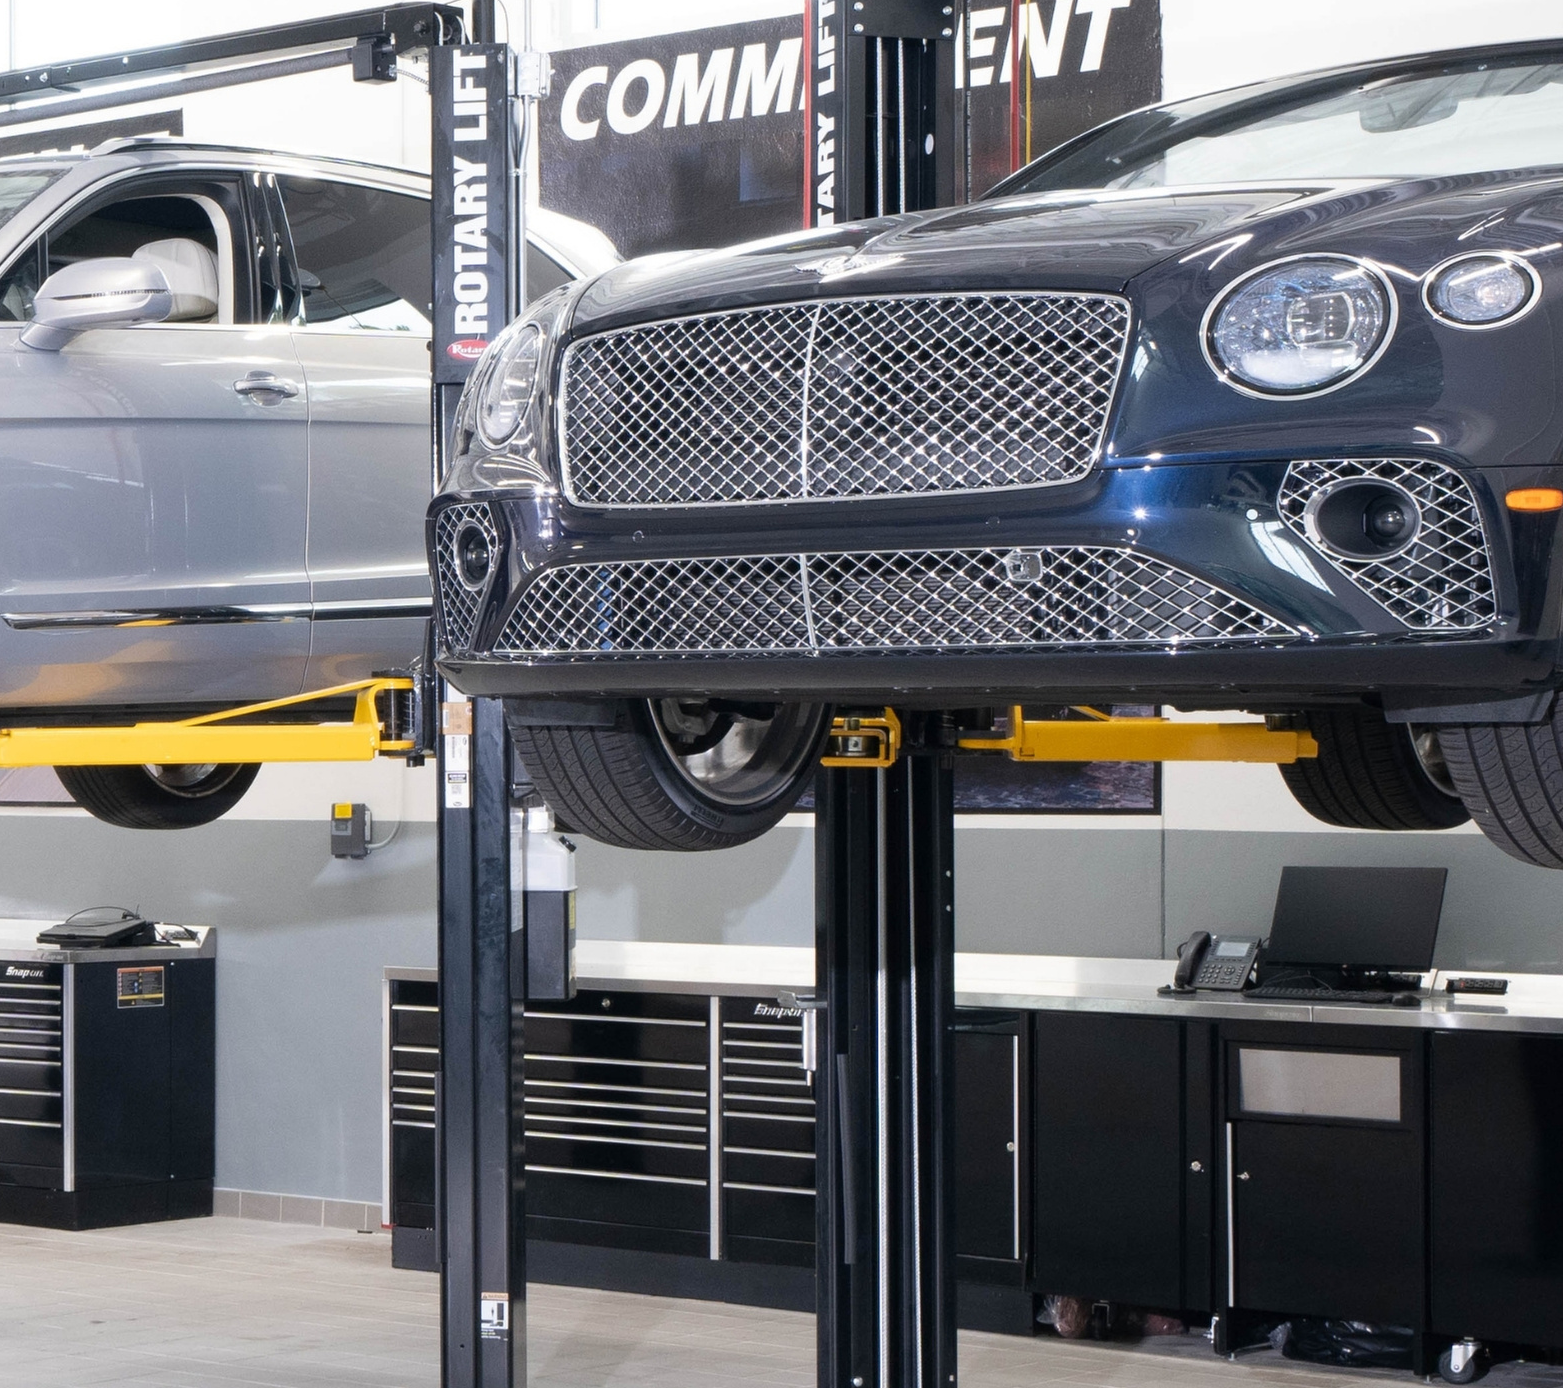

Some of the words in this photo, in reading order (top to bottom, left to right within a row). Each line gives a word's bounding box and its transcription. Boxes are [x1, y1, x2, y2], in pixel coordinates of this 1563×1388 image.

[453, 49, 487, 143] LIFT
[817, 112, 835, 228] TARY
[453, 157, 488, 335] ROTARY
[452, 344, 485, 358] Rotar
